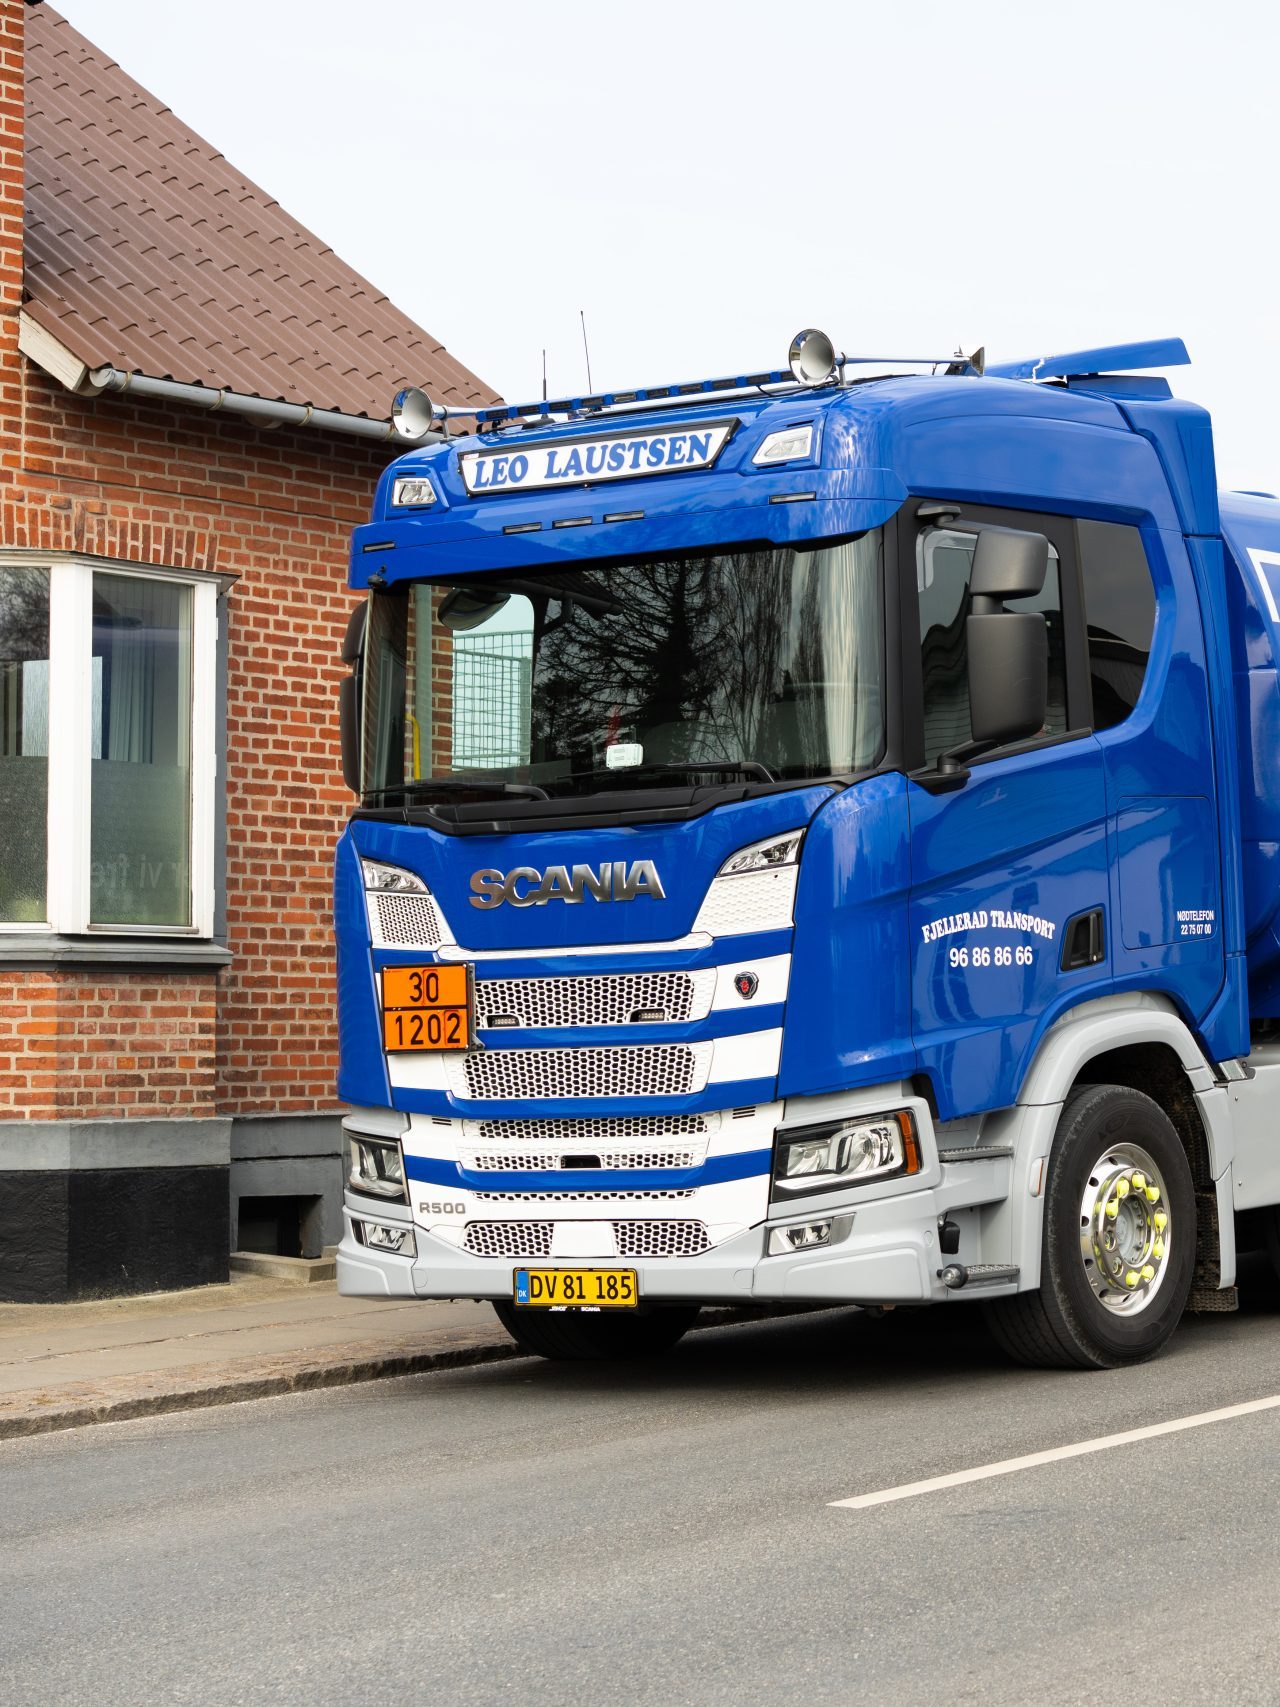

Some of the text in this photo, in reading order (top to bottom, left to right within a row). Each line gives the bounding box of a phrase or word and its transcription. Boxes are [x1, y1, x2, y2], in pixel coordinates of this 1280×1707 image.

[472, 432, 713, 489] LEO LAUSTSEN
[469, 859, 667, 910] SCANIA
[921, 910, 1056, 944] FJELLERAD TRANSPORT
[1180, 923, 1212, 935] 22 75 07 00
[949, 946, 1033, 968] 96 86 86 66
[409, 972, 439, 1003] 30
[395, 1012, 461, 1046] 1202
[419, 1202, 466, 1214] R500
[518, 1289, 527, 1298] DK
[530, 1275, 632, 1300] DV 81 185
